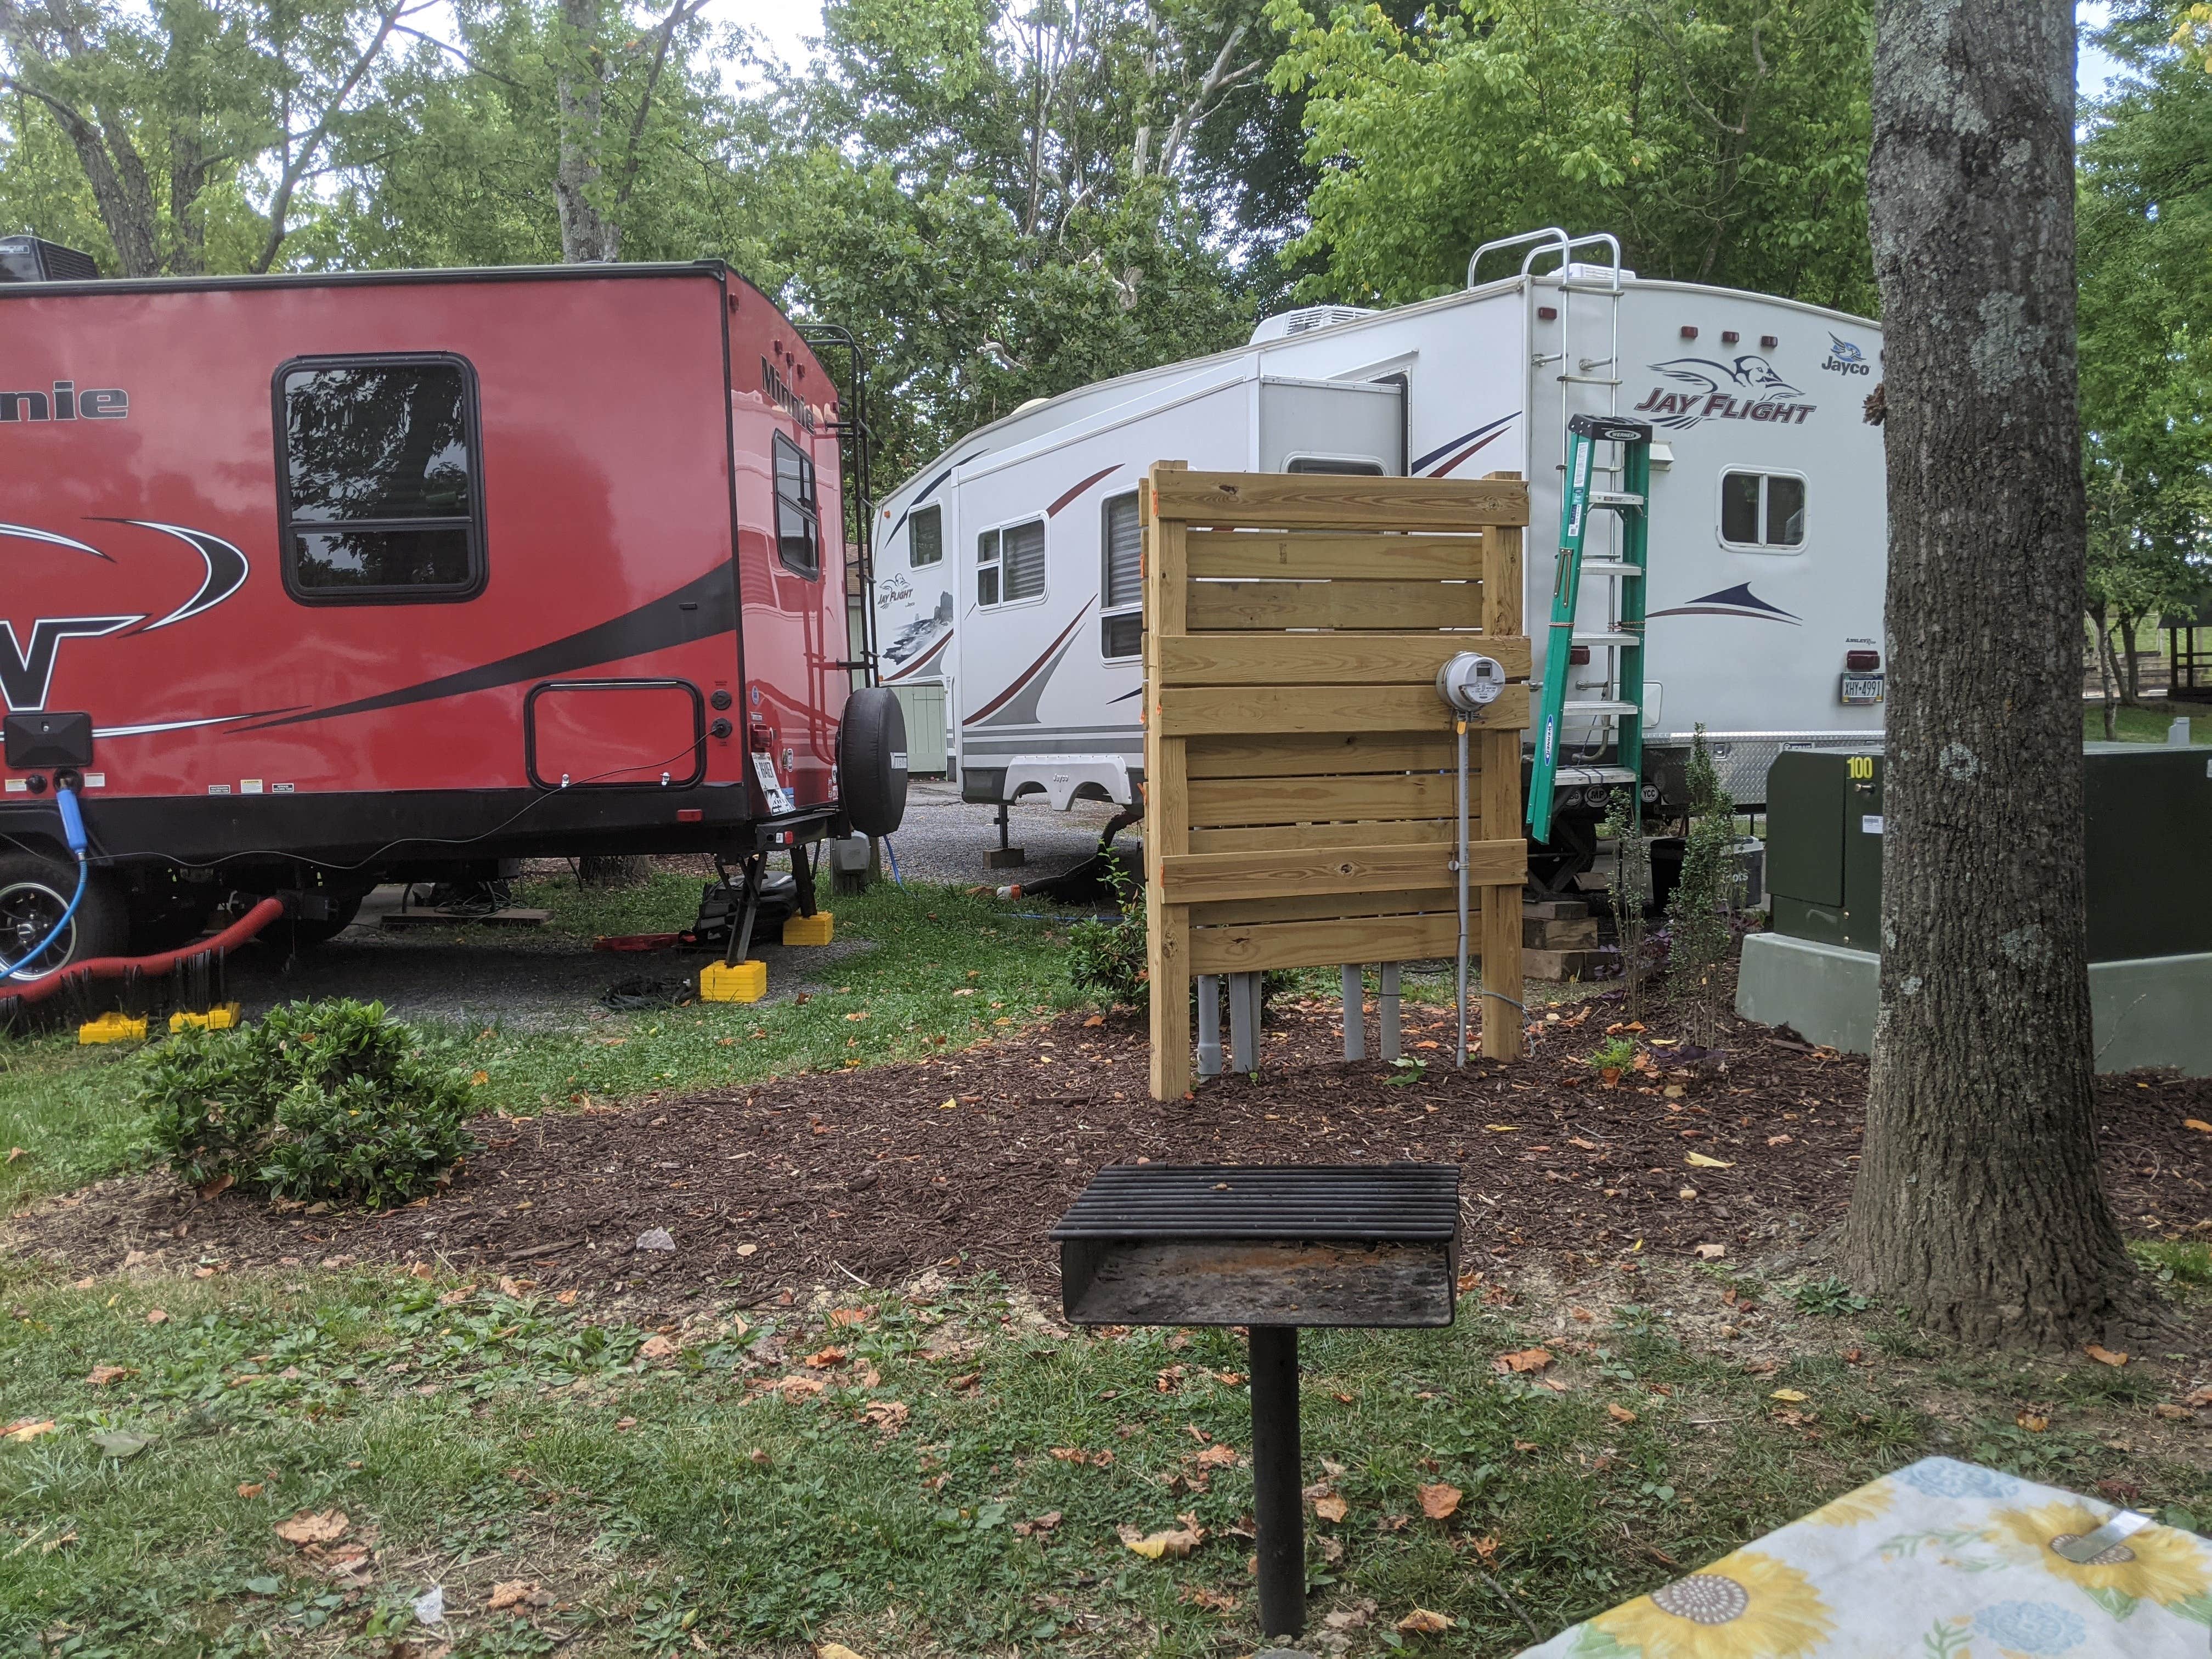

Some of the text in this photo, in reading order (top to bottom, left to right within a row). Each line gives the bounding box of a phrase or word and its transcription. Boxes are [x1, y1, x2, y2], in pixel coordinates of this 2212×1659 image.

[1821, 355, 1870, 376] Jayco
[760, 354, 815, 436] Minnie
[1634, 387, 1817, 424] JAY FLIGHT
[877, 588, 913, 605] JAY FLIGHT
[1053, 773, 1069, 783] Jayco
[1847, 757, 1873, 778] 100
[1643, 789, 1655, 798] YCC
